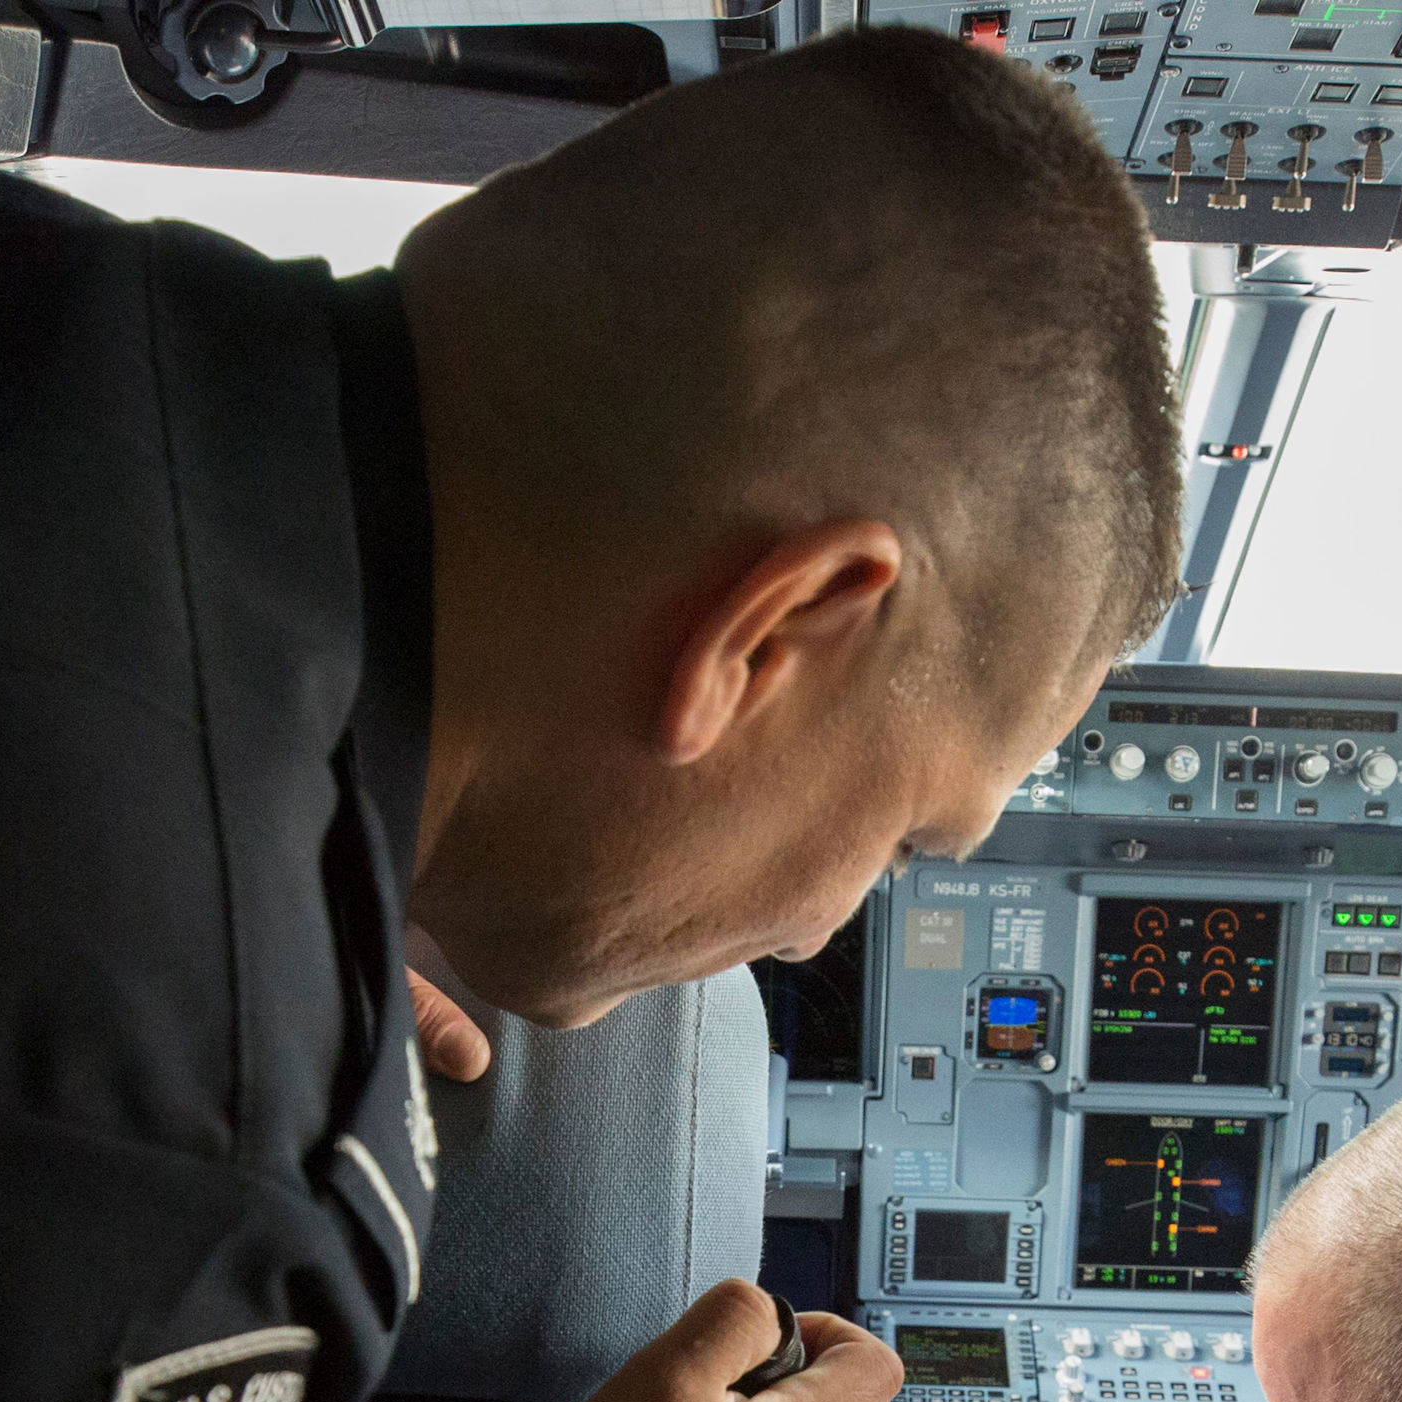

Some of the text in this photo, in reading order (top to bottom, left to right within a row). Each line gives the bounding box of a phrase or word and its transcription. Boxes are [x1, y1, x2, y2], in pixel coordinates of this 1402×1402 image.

[1026, 6, 1087, 15] PASSENGER
[988, 884, 1032, 898] KS-FR
[919, 914, 940, 927] CAT
